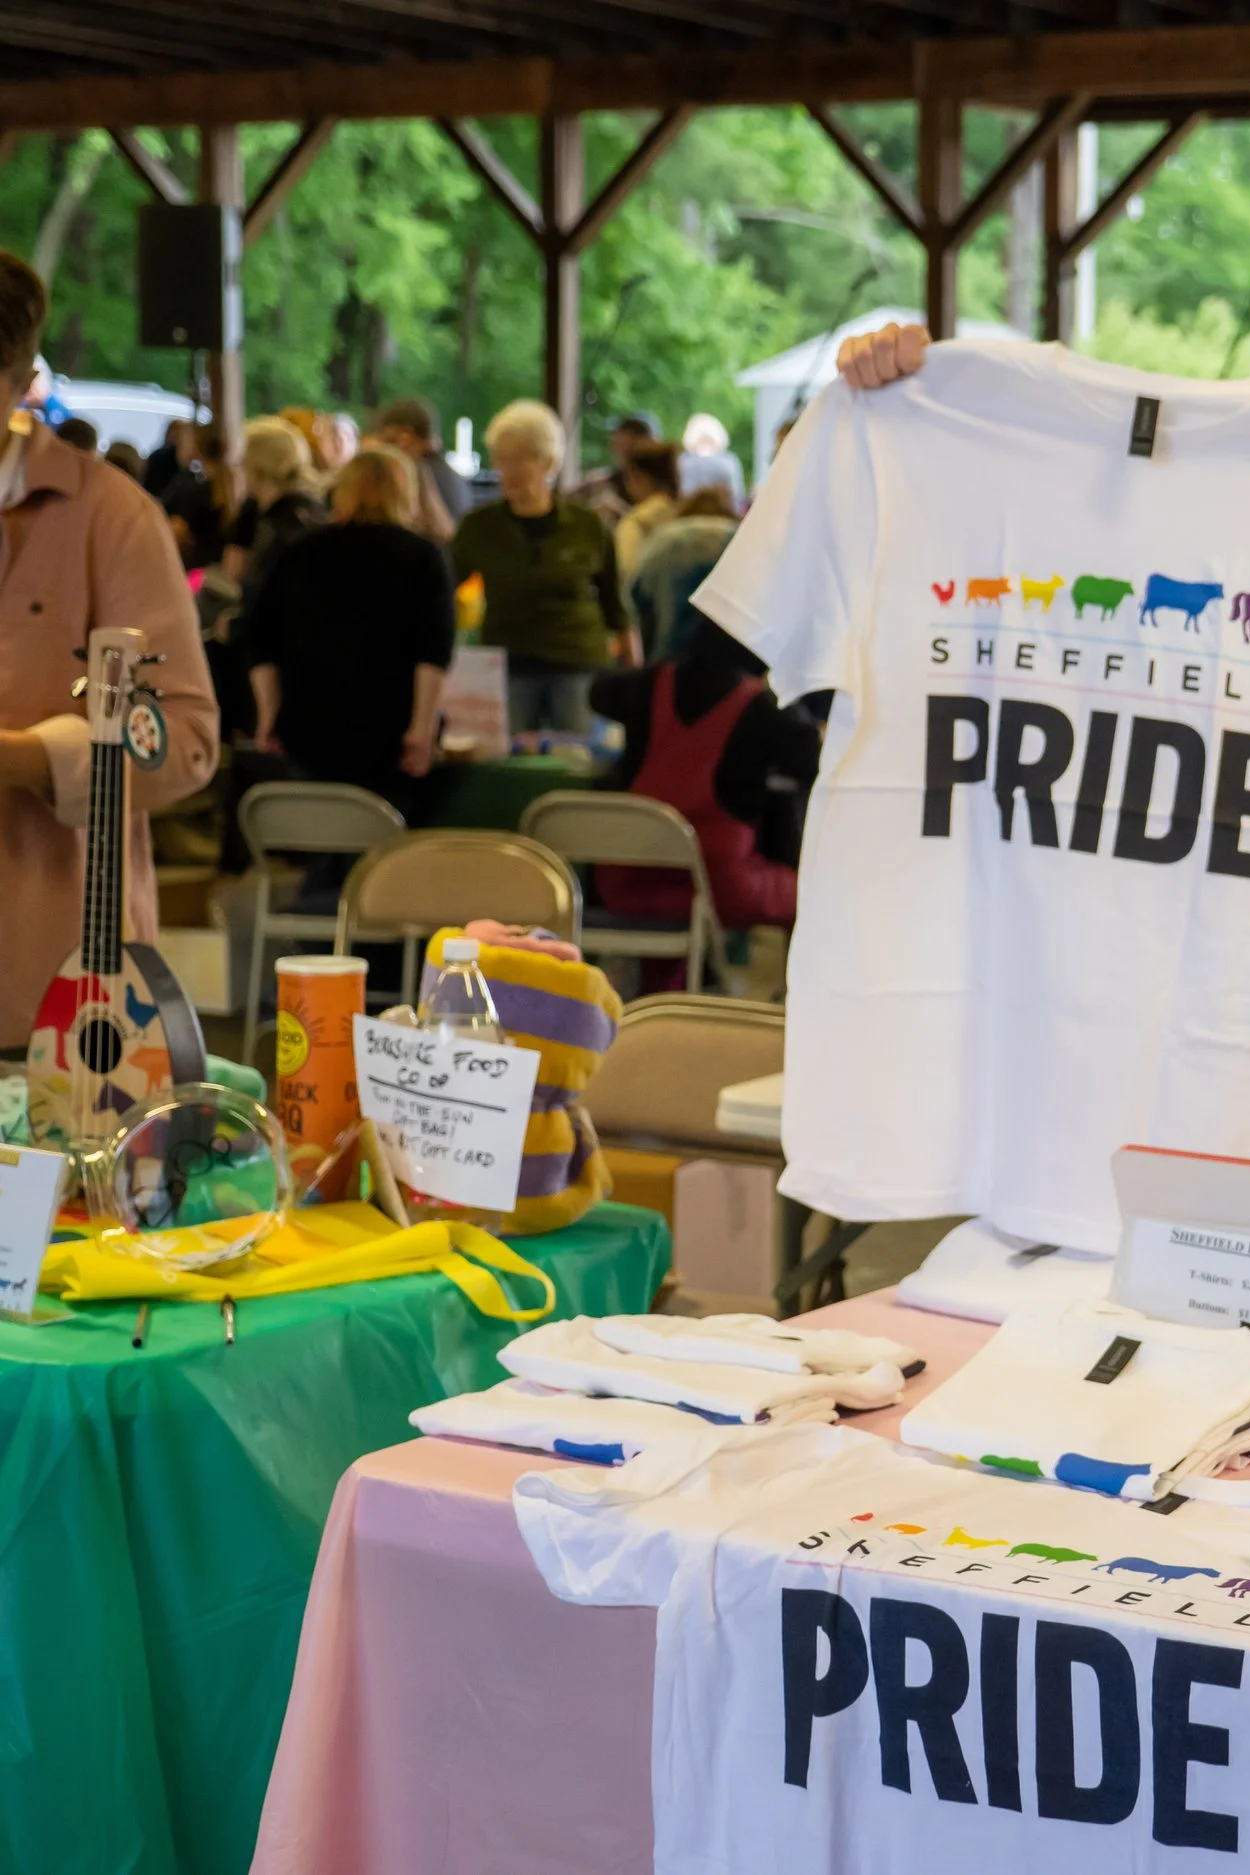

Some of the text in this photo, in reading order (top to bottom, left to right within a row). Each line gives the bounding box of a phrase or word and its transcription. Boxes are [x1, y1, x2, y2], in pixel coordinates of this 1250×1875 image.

[397, 1065, 421, 1087] CO
[452, 1050, 509, 1078] FOOD
[454, 1149, 496, 1168] CARD
[1170, 1226, 1245, 1253] SHEFFIELD
[780, 1587, 1246, 1854] PRIDE
